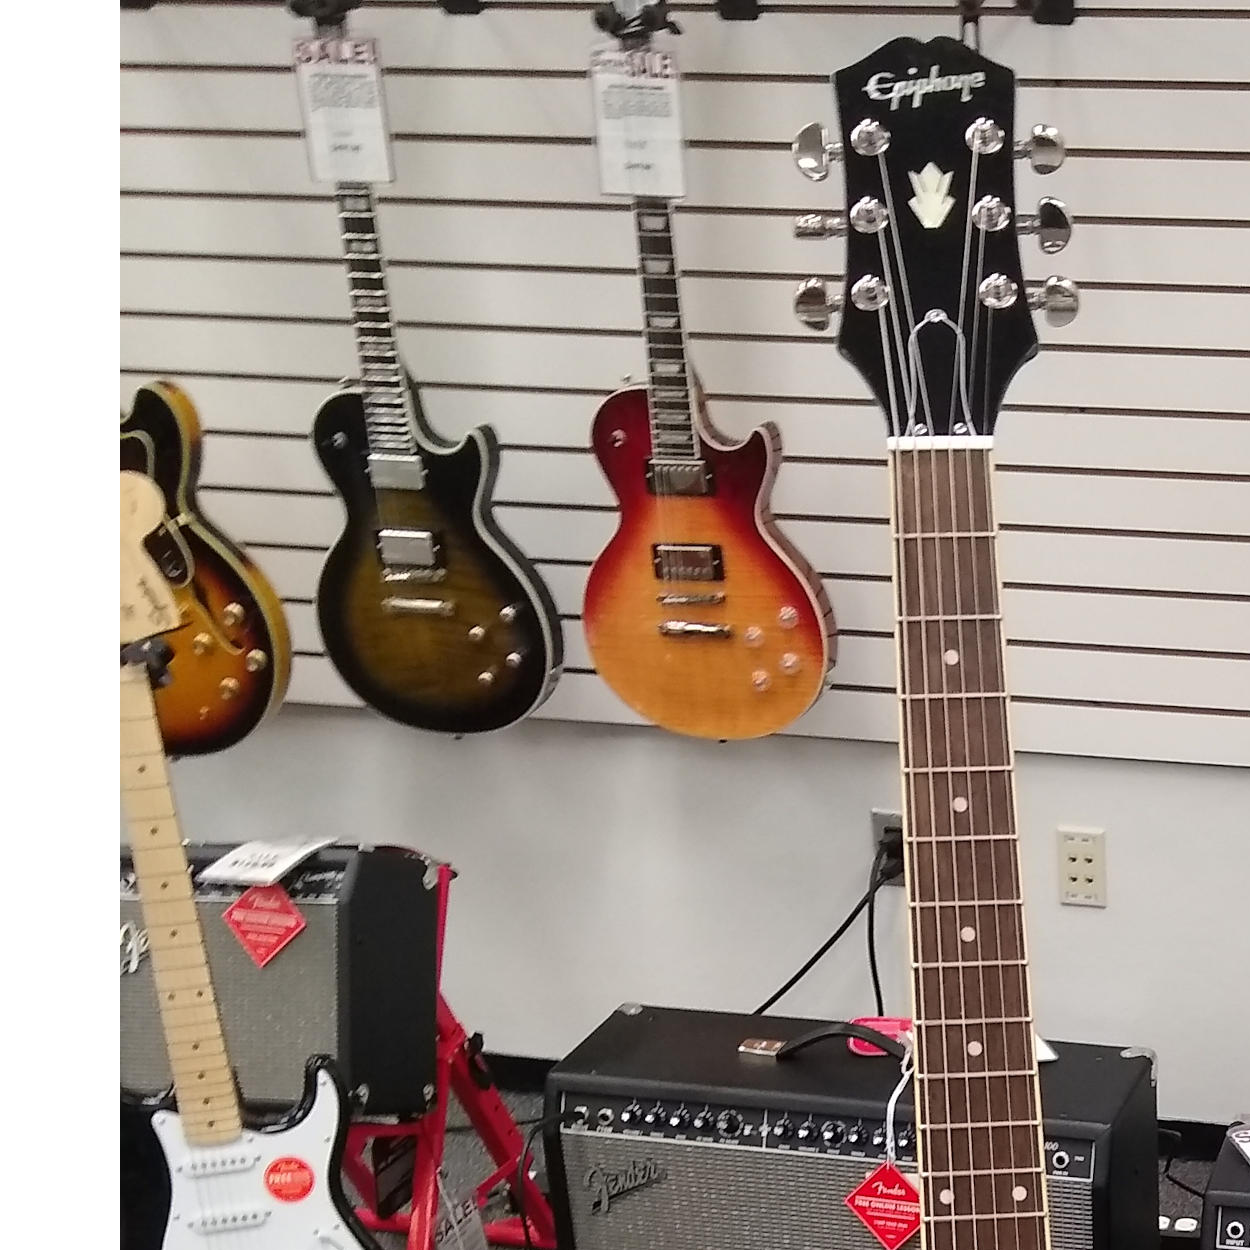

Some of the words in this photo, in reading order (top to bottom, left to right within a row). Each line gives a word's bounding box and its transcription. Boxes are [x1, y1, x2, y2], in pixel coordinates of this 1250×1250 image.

[861, 64, 987, 111] Epiphone
[583, 1156, 668, 1216] Fender
[871, 1181, 906, 1196] Fender
